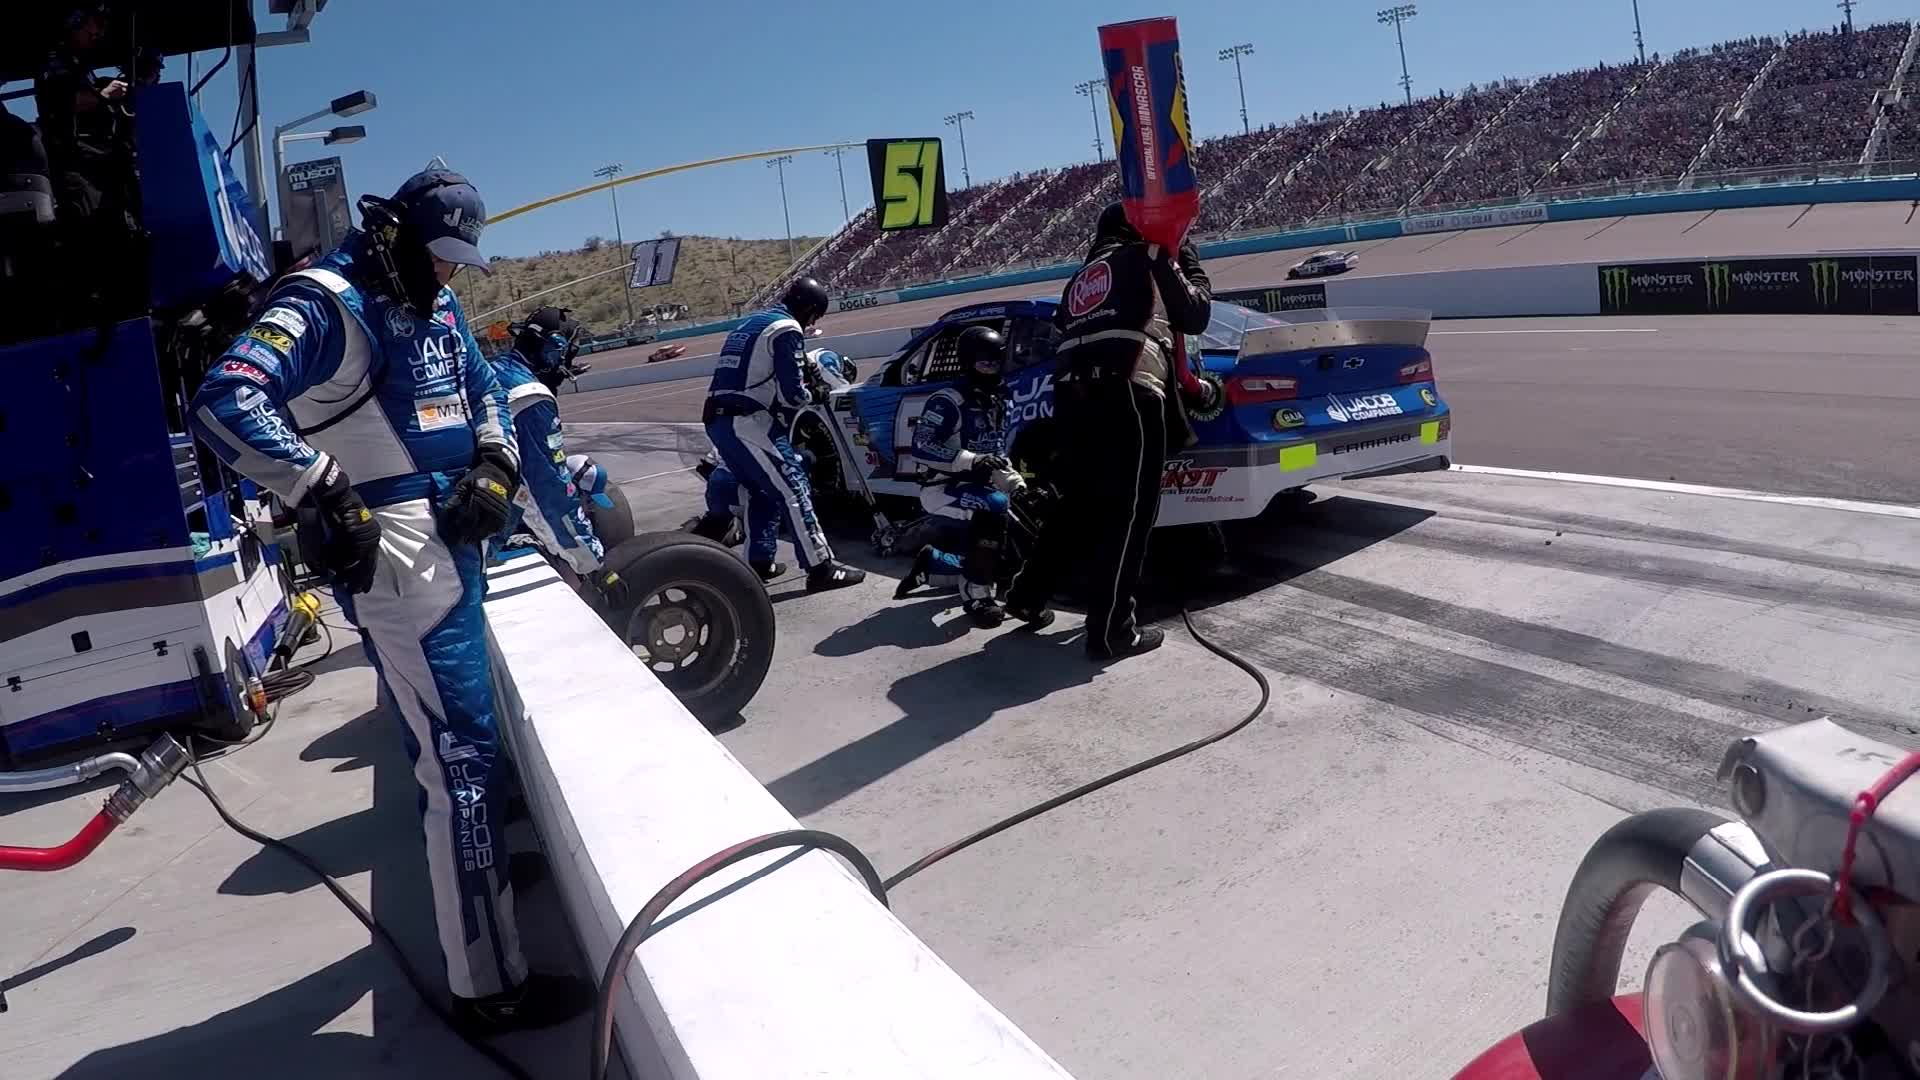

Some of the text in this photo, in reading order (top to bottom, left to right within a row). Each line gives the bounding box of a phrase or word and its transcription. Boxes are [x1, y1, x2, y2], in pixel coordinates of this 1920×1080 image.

[1131, 66, 1152, 112] NASCAR
[880, 141, 939, 229] 51
[630, 237, 682, 289] 11
[1631, 273, 1694, 287] MONSTER
[1732, 270, 1800, 284] MONSTER
[1841, 269, 1914, 283] MONSTER
[839, 297, 878, 311] DOGLEG
[1072, 271, 1108, 313] Rheem
[1282, 293, 1325, 304] MONSTER
[408, 334, 454, 366] JAC
[1347, 393, 1398, 412] JACOB
[1353, 406, 1404, 421] COMPANIES
[1333, 432, 1412, 456] CAMARO
[449, 764, 476, 872] COMPANIES
[462, 763, 494, 869] JACOB
